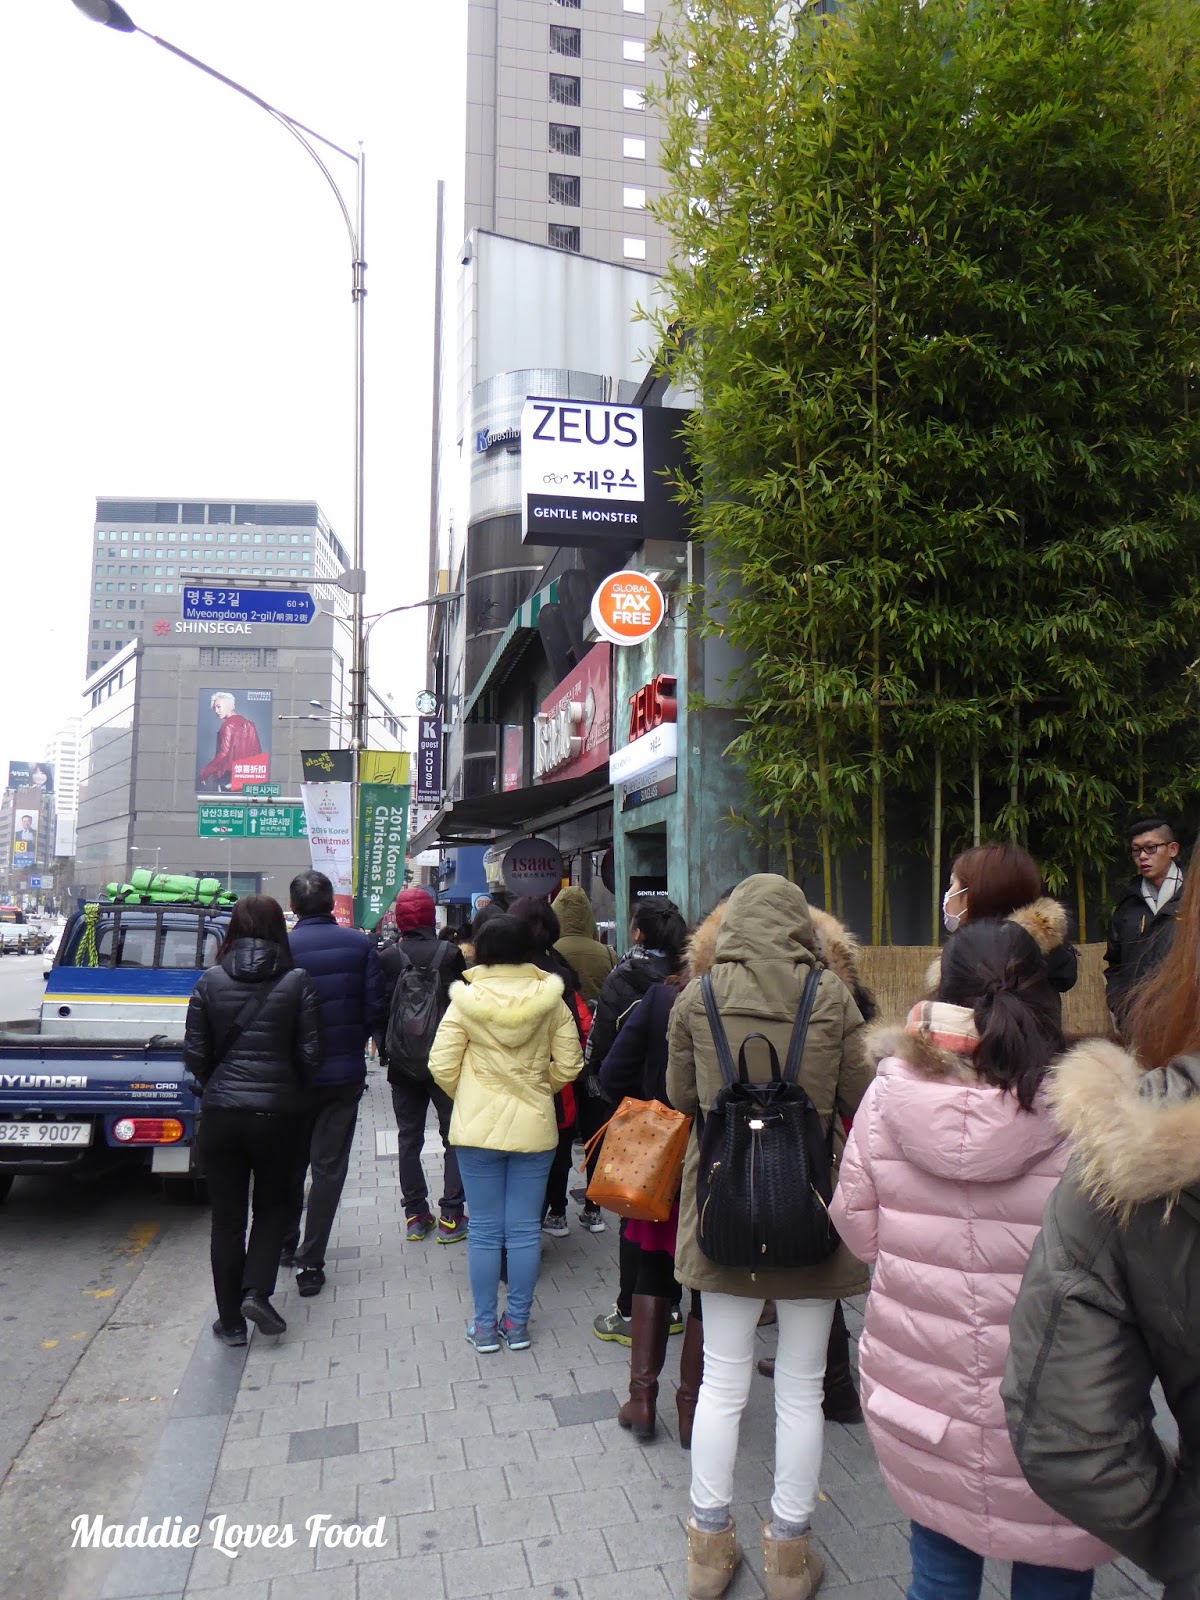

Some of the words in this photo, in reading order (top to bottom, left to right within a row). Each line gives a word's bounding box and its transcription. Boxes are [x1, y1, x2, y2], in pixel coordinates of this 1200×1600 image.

[532, 404, 638, 448] ZEUS
[572, 468, 638, 493] 제우스
[534, 507, 578, 520] GENTLE
[582, 510, 639, 524] MONSTER
[612, 583, 650, 594] GLOBAL
[186, 590, 240, 607] 명동2길
[286, 600, 297, 608] 60
[611, 593, 651, 610] TAX
[186, 607, 248, 621] Myeongdong
[612, 612, 651, 626] FREE
[175, 622, 252, 634] SHINSEGAE
[628, 674, 677, 744] ZEUS
[423, 721, 437, 739] K
[420, 740, 439, 750] guest
[425, 750, 433, 788] HOUSE
[201, 808, 244, 818] 남산3호터널
[388, 807, 403, 842] 2016
[371, 806, 389, 881] Christmas
[385, 845, 400, 886] Korea
[370, 885, 384, 914] Fair
[0, 1075, 87, 1088] YUNDAI
[38, 1125, 82, 1142] 9007
